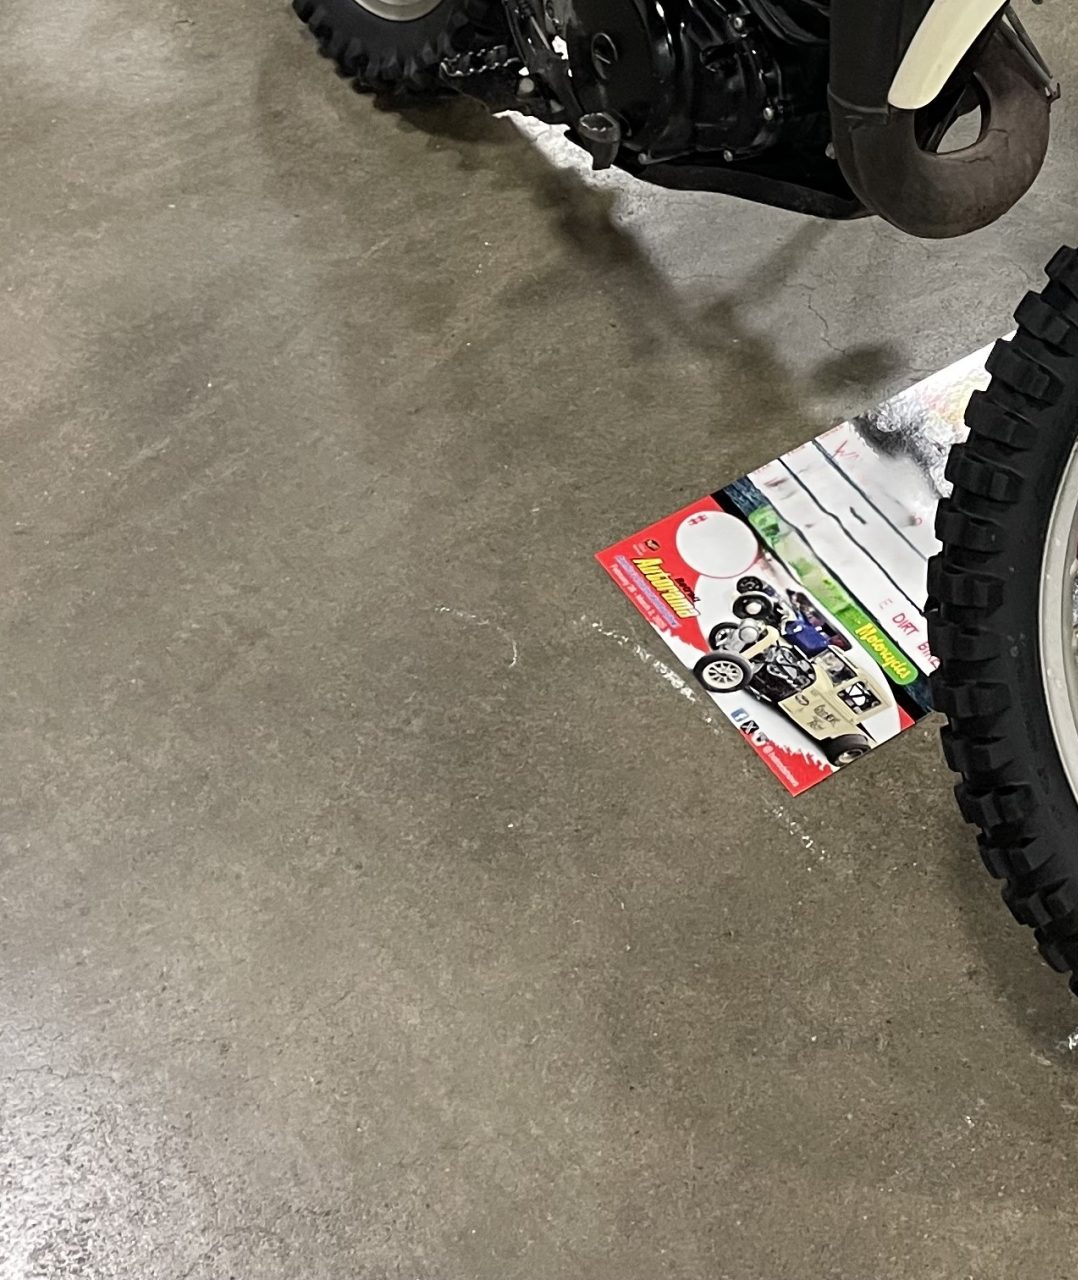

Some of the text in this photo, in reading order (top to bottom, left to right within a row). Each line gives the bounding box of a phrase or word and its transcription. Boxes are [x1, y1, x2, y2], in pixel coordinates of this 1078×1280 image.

[632, 557, 699, 618] Autorama
[854, 622, 910, 679] Motorcycles
[891, 611, 919, 636] DIRT
